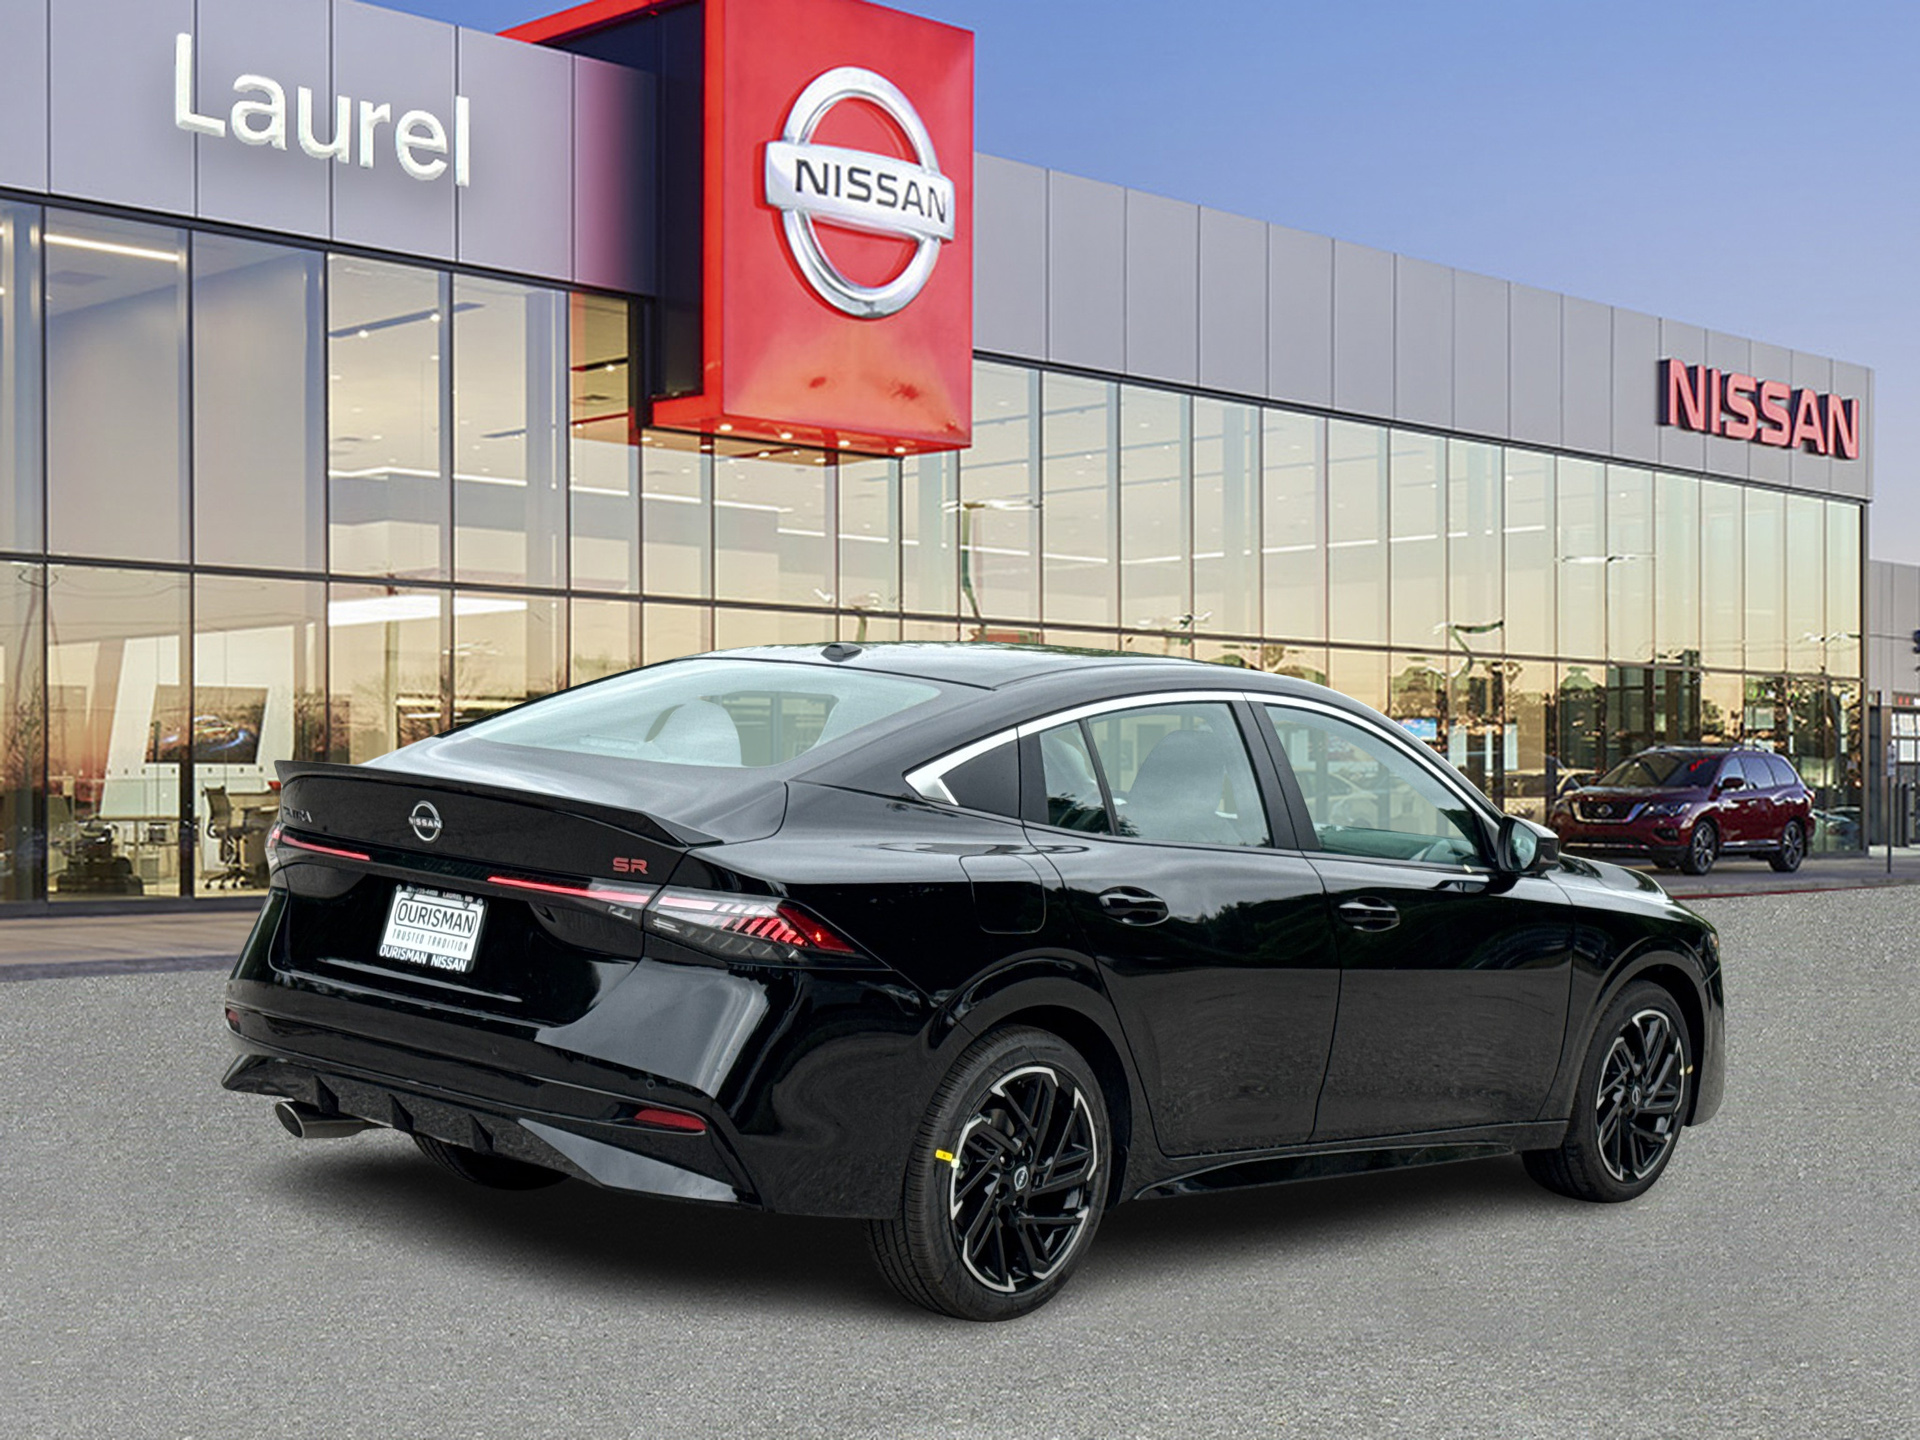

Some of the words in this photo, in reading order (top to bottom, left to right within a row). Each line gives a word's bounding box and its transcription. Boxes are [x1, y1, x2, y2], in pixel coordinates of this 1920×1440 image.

[175, 33, 469, 187] Laurel
[795, 159, 946, 223] NISSAN
[1658, 358, 1859, 460] NISSAN
[408, 816, 442, 829] NISSAN
[613, 857, 649, 875] SR
[398, 903, 475, 933] OURISMAN
[392, 928, 425, 944] TRUSTED
[427, 935, 468, 952] TRADITION
[379, 944, 428, 965] OURISMAN
[430, 954, 467, 972] NISSAN
